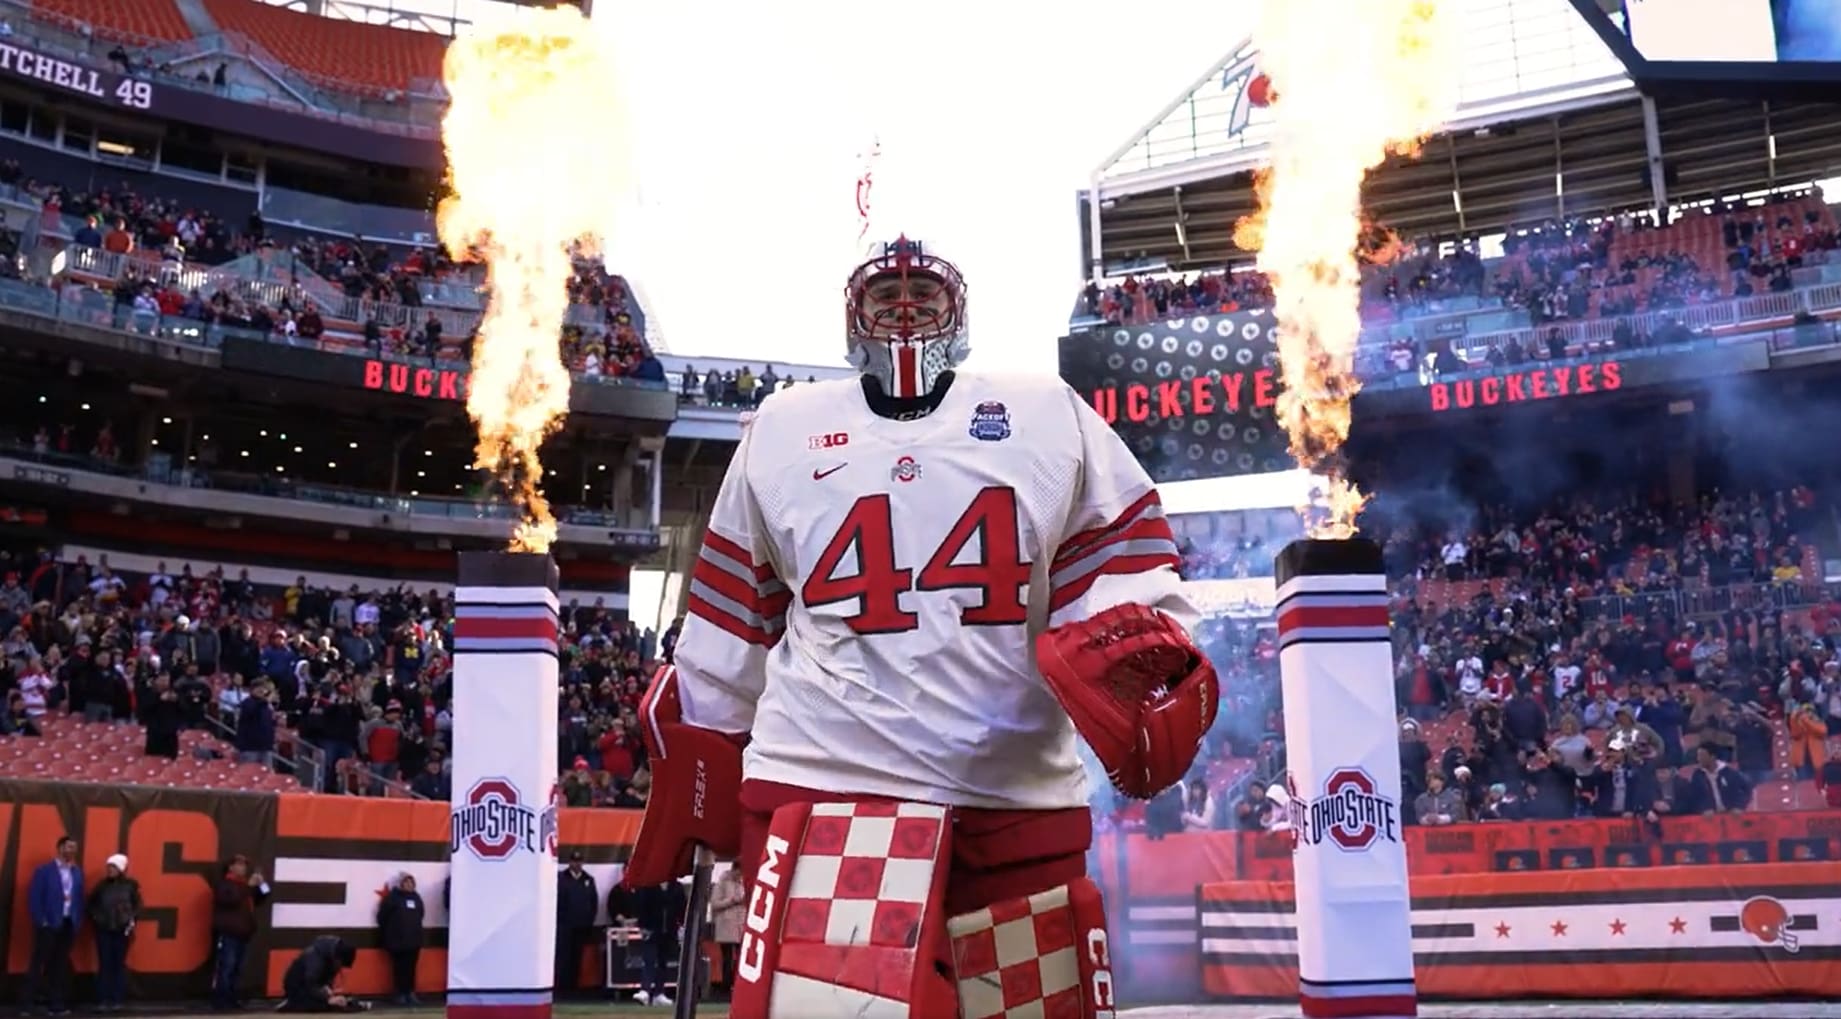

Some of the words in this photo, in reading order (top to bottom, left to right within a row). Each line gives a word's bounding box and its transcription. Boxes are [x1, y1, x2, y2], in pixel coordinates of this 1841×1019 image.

[116, 79, 152, 109] 49
[1079, 369, 1275, 425] UCKEYE
[1431, 361, 1621, 411] BUCKEYES
[802, 486, 1032, 634] 44
[487, 799, 535, 854] STATE
[1310, 794, 1345, 845] OHIO
[1344, 788, 1396, 843] STATE
[0, 802, 219, 974] NS
[738, 834, 790, 983] CCM
